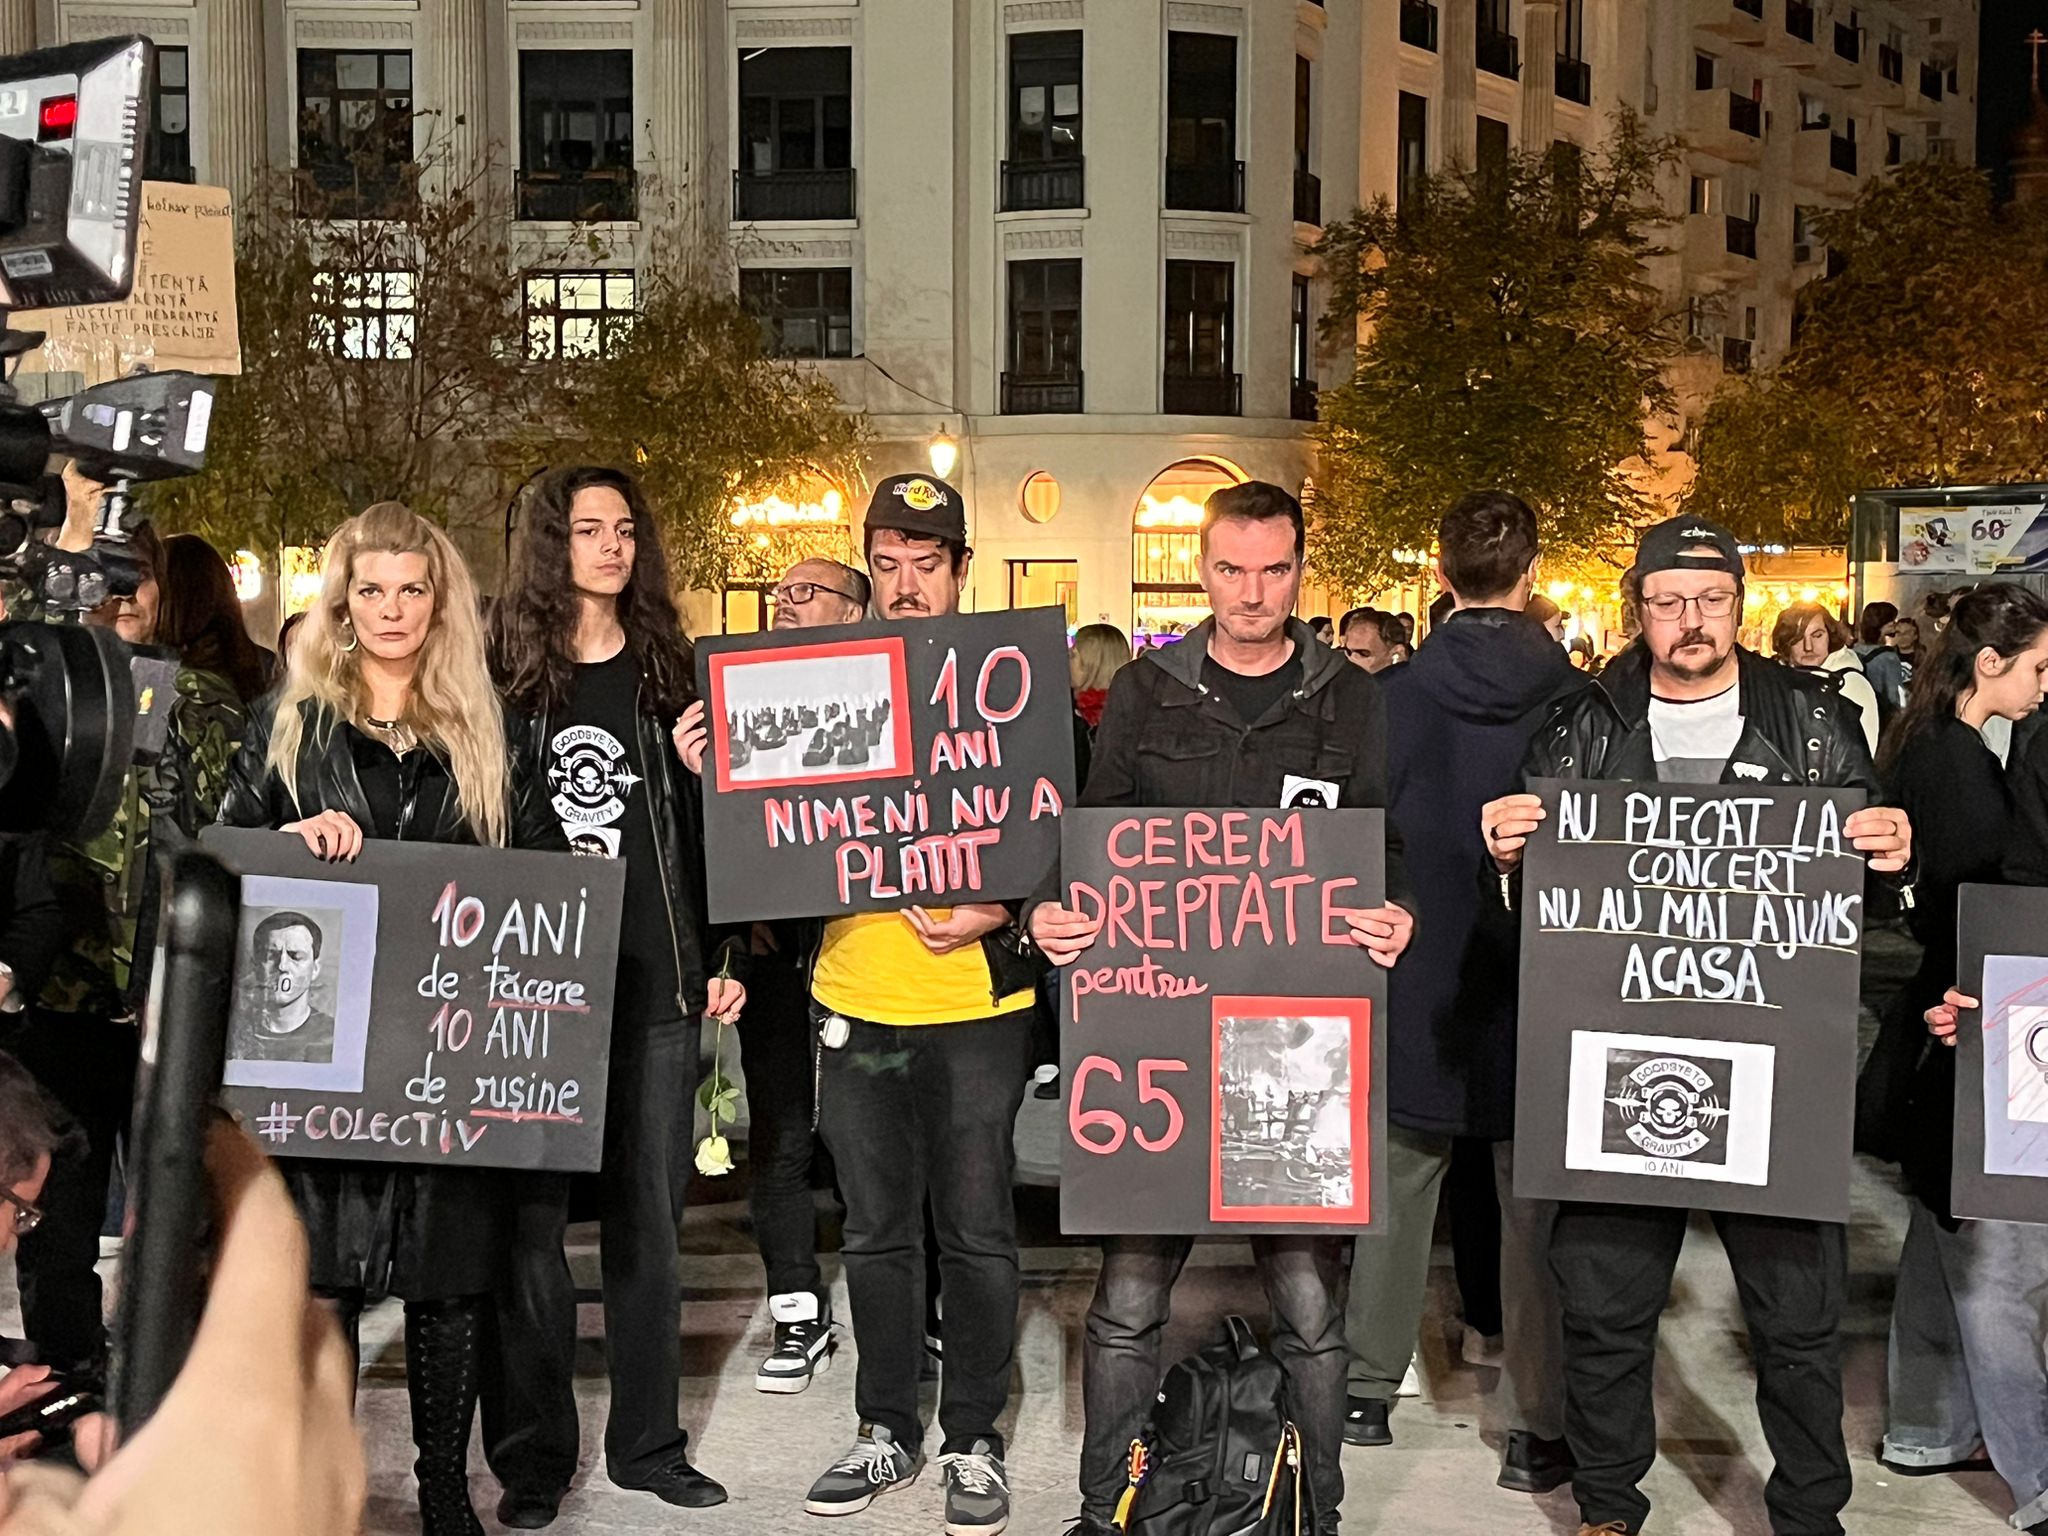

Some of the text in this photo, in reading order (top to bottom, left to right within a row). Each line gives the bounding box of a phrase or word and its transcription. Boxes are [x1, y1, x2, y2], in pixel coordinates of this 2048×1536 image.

[929, 646, 1032, 728] 10
[554, 729, 619, 756] GOODBYE TO
[564, 806, 613, 823] GRAVITY
[950, 784, 1011, 831] NU
[1029, 777, 1064, 821] A
[1557, 790, 1841, 857] AU PLECAT LA
[1107, 811, 1306, 868] CEREM
[1627, 848, 1811, 896] CONCERT
[431, 880, 485, 947] 10
[1069, 871, 1360, 951] DREPTATE
[1538, 886, 1863, 960] NU AU MAI AJUNS
[417, 953, 460, 1000] de
[1070, 953, 1209, 1024] pentru
[428, 1002, 549, 1059] 10 ANI
[405, 1052, 446, 1104] de
[1636, 1061, 1707, 1087] GOODBYE TO
[1068, 1054, 1189, 1154] 65
[1641, 1136, 1692, 1155] GRAVITY
[1660, 1163, 1685, 1176] ANI
